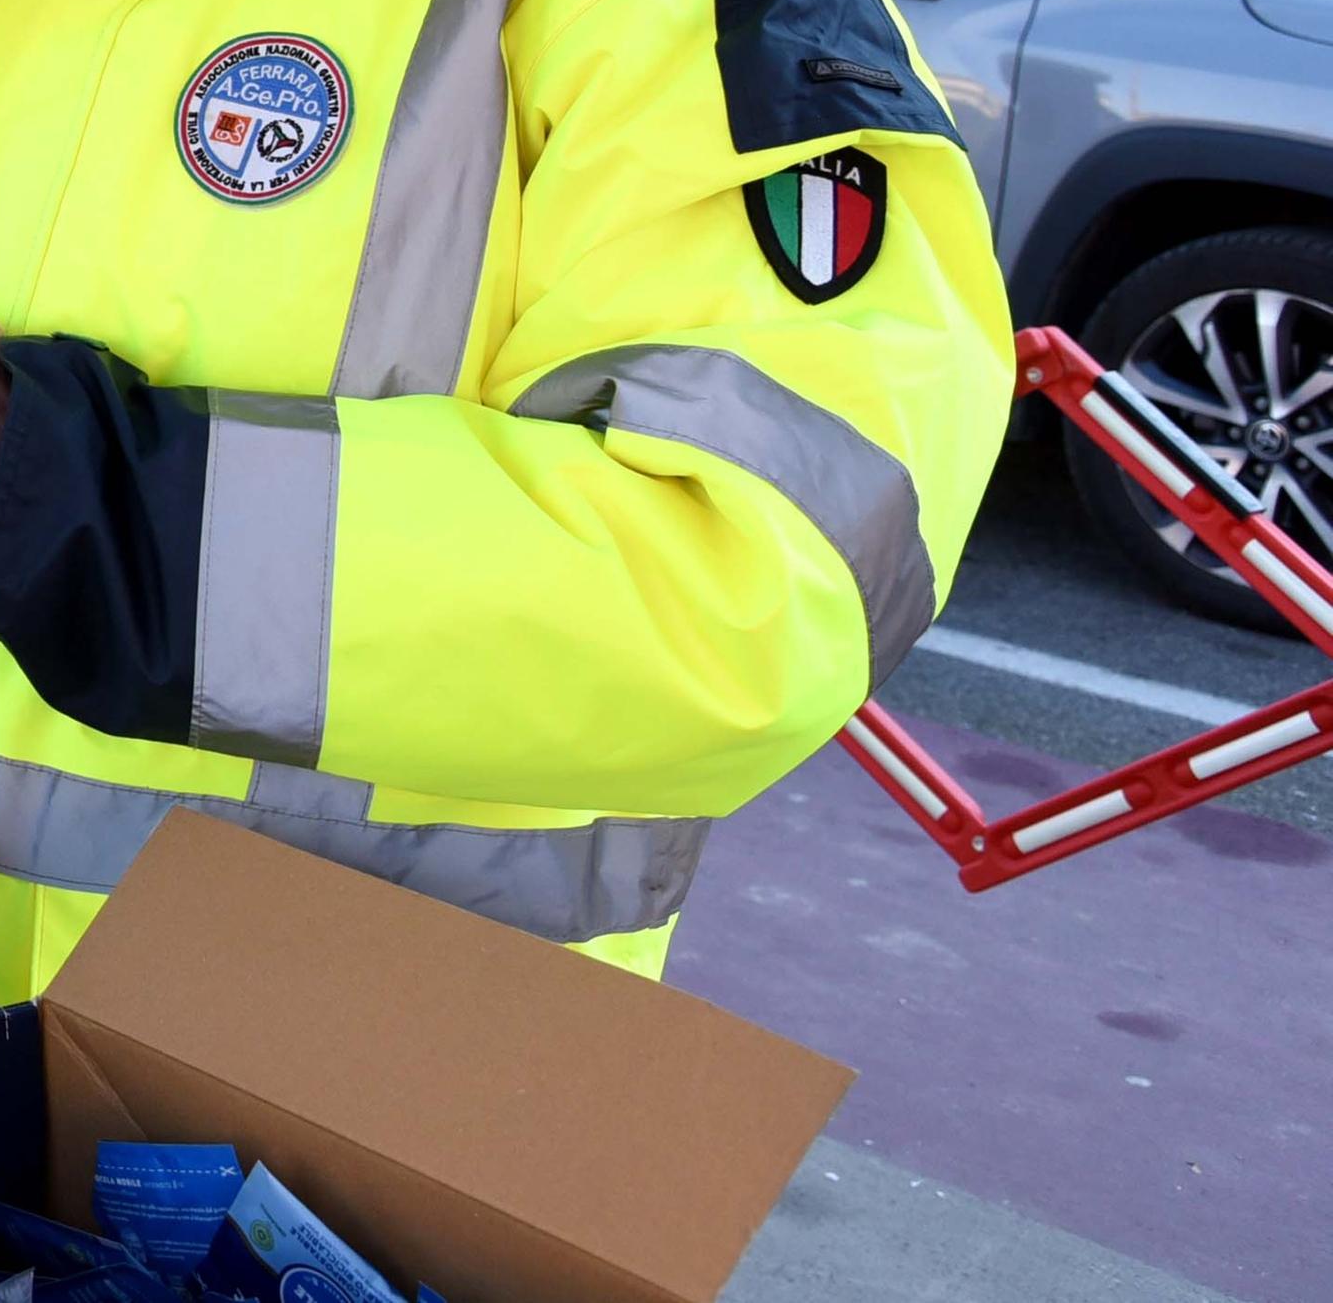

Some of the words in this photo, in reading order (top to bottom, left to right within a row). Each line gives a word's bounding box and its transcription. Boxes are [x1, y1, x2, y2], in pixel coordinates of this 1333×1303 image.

[194, 46, 261, 100] ASSOCIAZIONE
[265, 45, 321, 70] NAZIONALE
[239, 64, 317, 97] FERRARA
[187, 111, 200, 144] CIVILE
[292, 122, 339, 177] VOLONTARI
[193, 147, 246, 191] PROTEZIONE
[269, 172, 291, 189] PER
[799, 155, 862, 186] ALIA
[250, 181, 265, 192] LA
